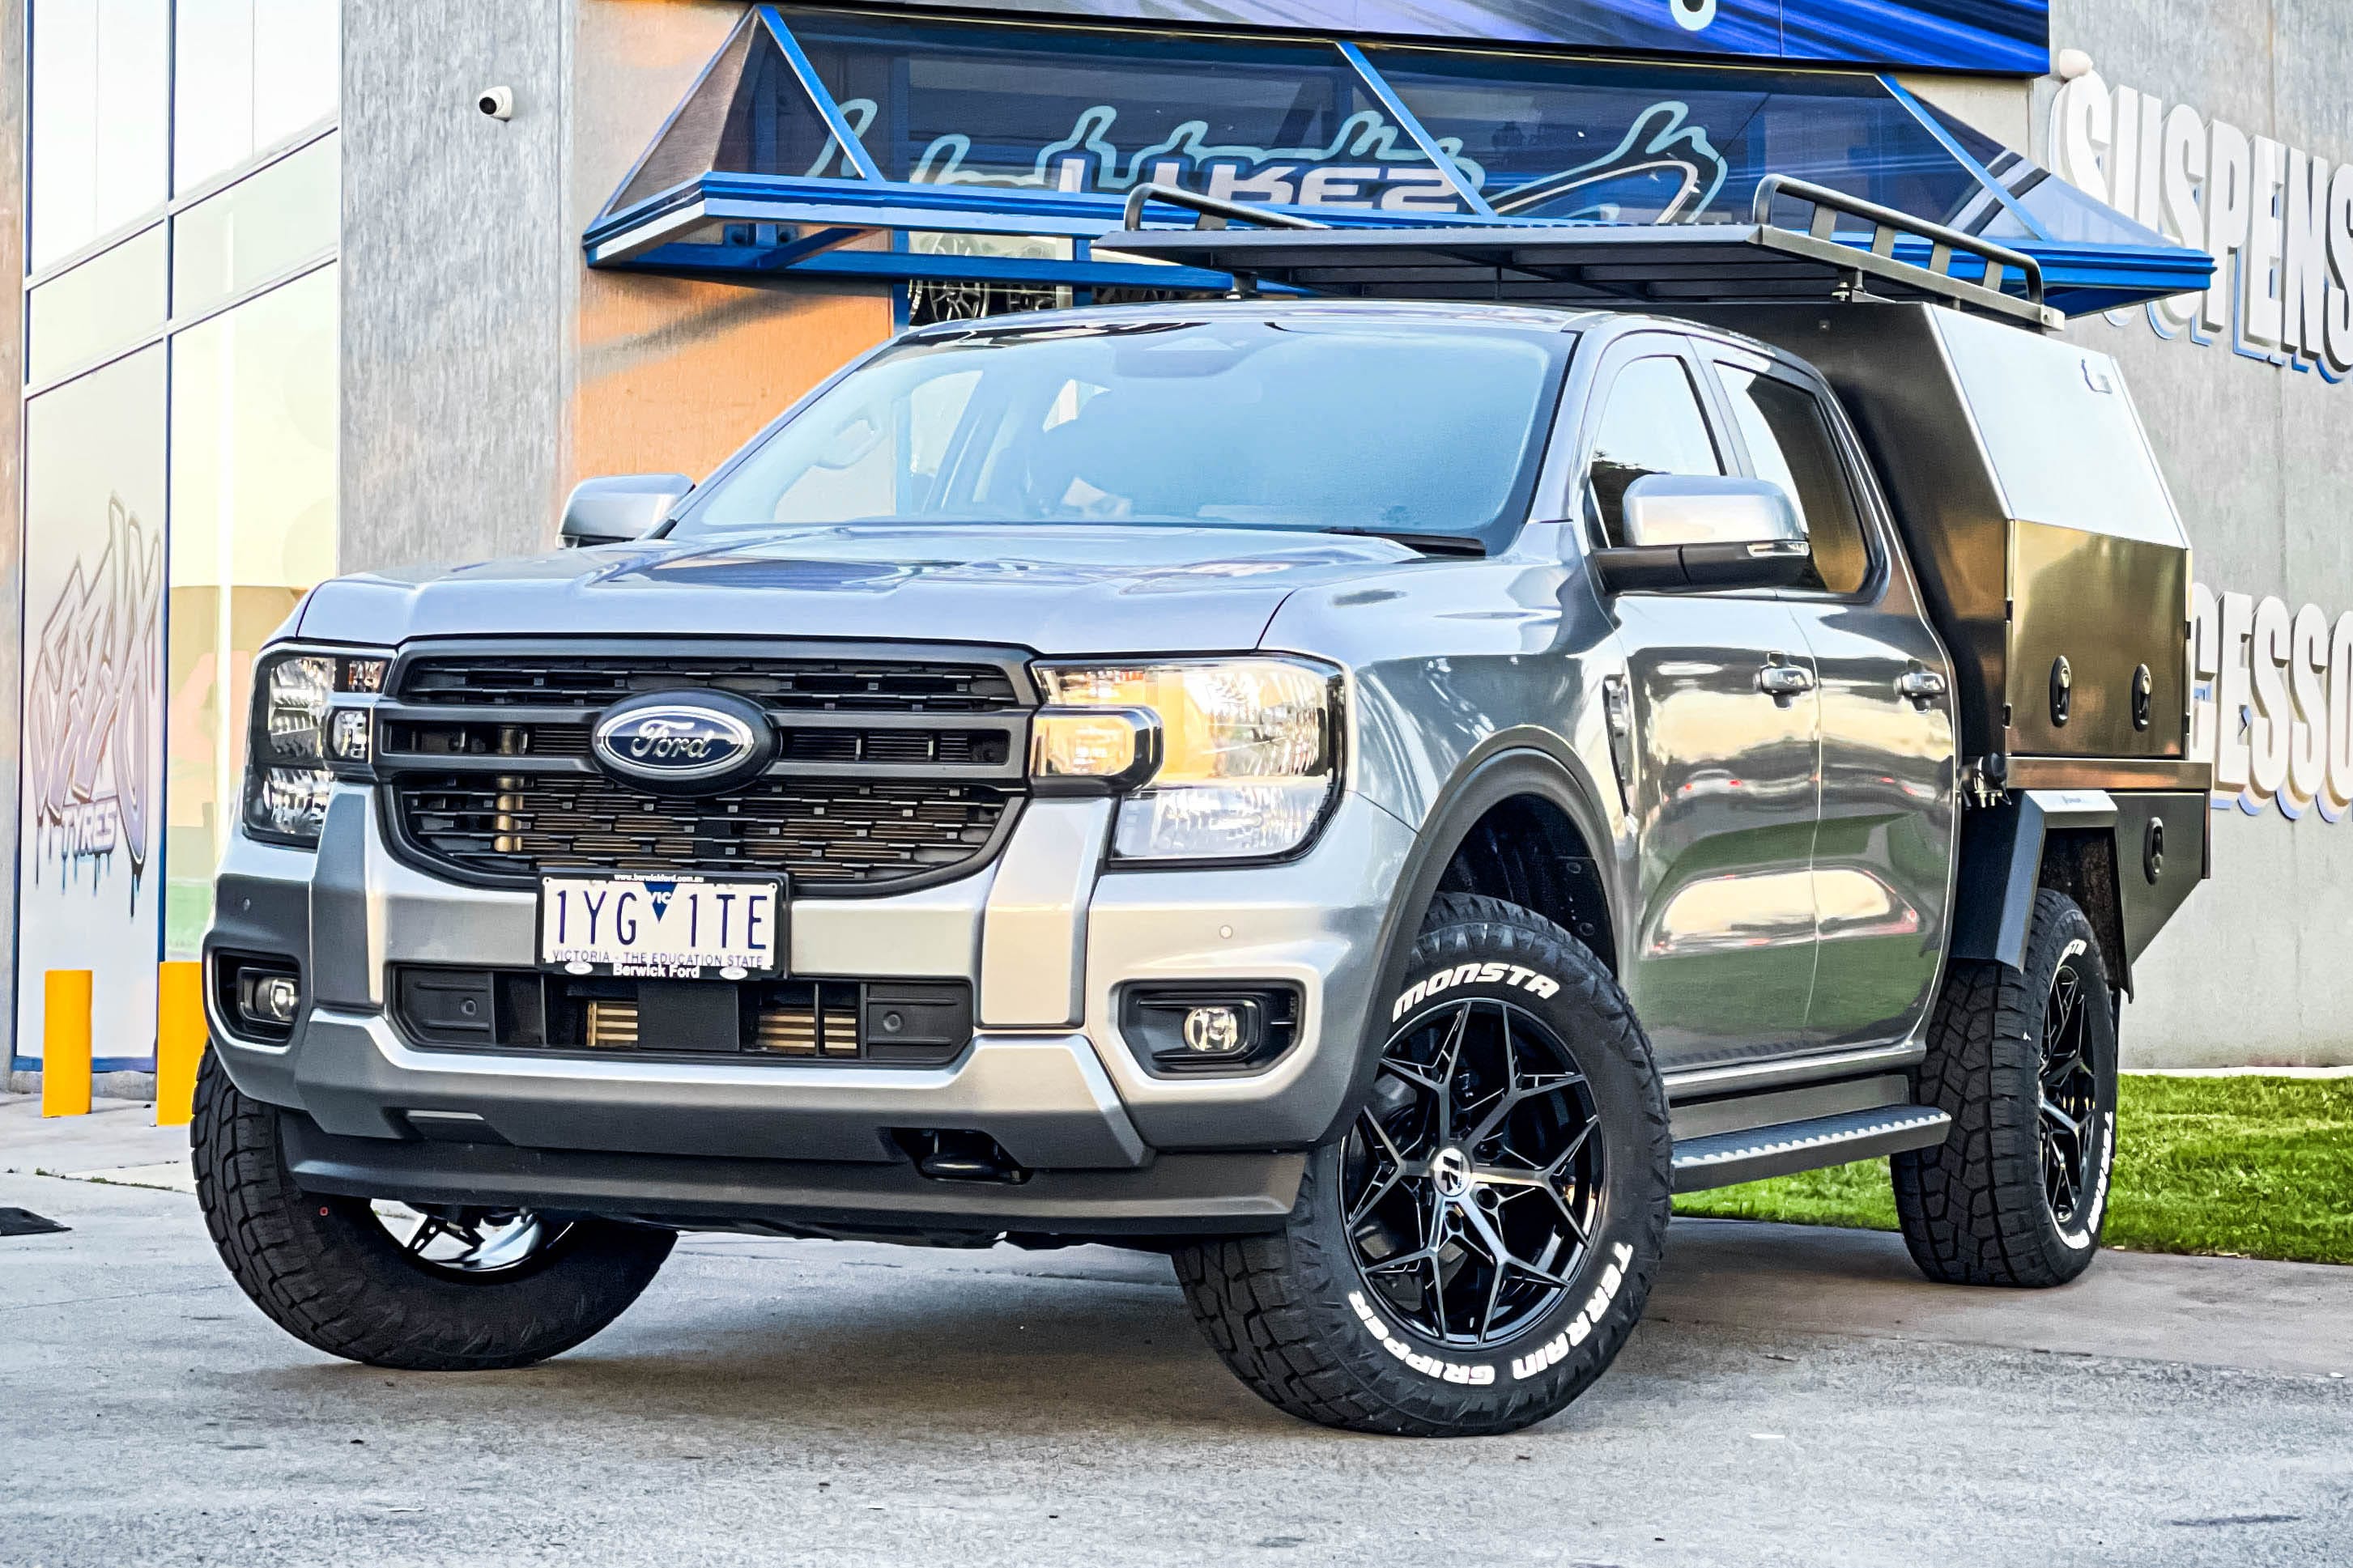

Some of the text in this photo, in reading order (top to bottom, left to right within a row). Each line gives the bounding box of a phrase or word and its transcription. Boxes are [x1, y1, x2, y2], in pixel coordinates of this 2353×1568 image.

[630, 719, 716, 759] Ford
[62, 801, 117, 856] TYRES
[557, 890, 768, 950] 1YG 1TE
[649, 891, 672, 904] VIC
[552, 950, 610, 963] VICTORIA
[623, 951, 648, 964] THE
[651, 952, 722, 967] EDUCATION
[726, 955, 764, 968] STATE
[612, 962, 700, 979] Berwick Ford
[1392, 962, 1560, 1022] MONSTA
[1348, 1241, 1633, 1385] TERRAIN GRIPPER
